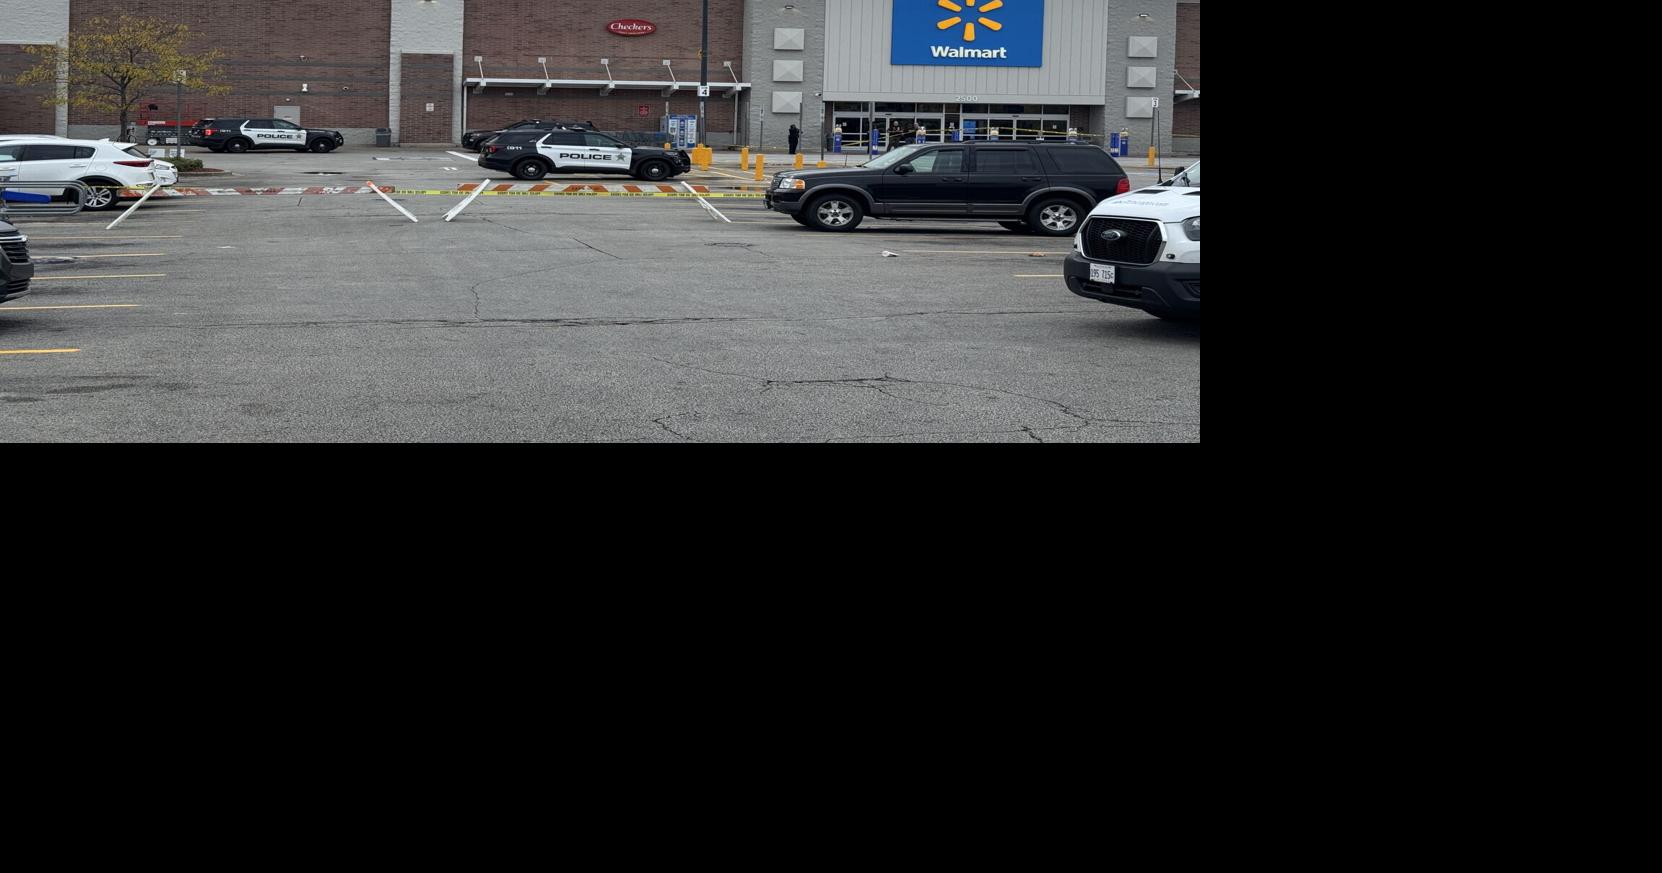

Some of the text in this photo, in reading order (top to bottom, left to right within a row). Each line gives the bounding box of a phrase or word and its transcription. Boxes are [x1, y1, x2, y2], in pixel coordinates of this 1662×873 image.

[610, 22, 652, 31] Checkers
[930, 45, 1007, 60] Walmart
[559, 152, 612, 161] POLICE
